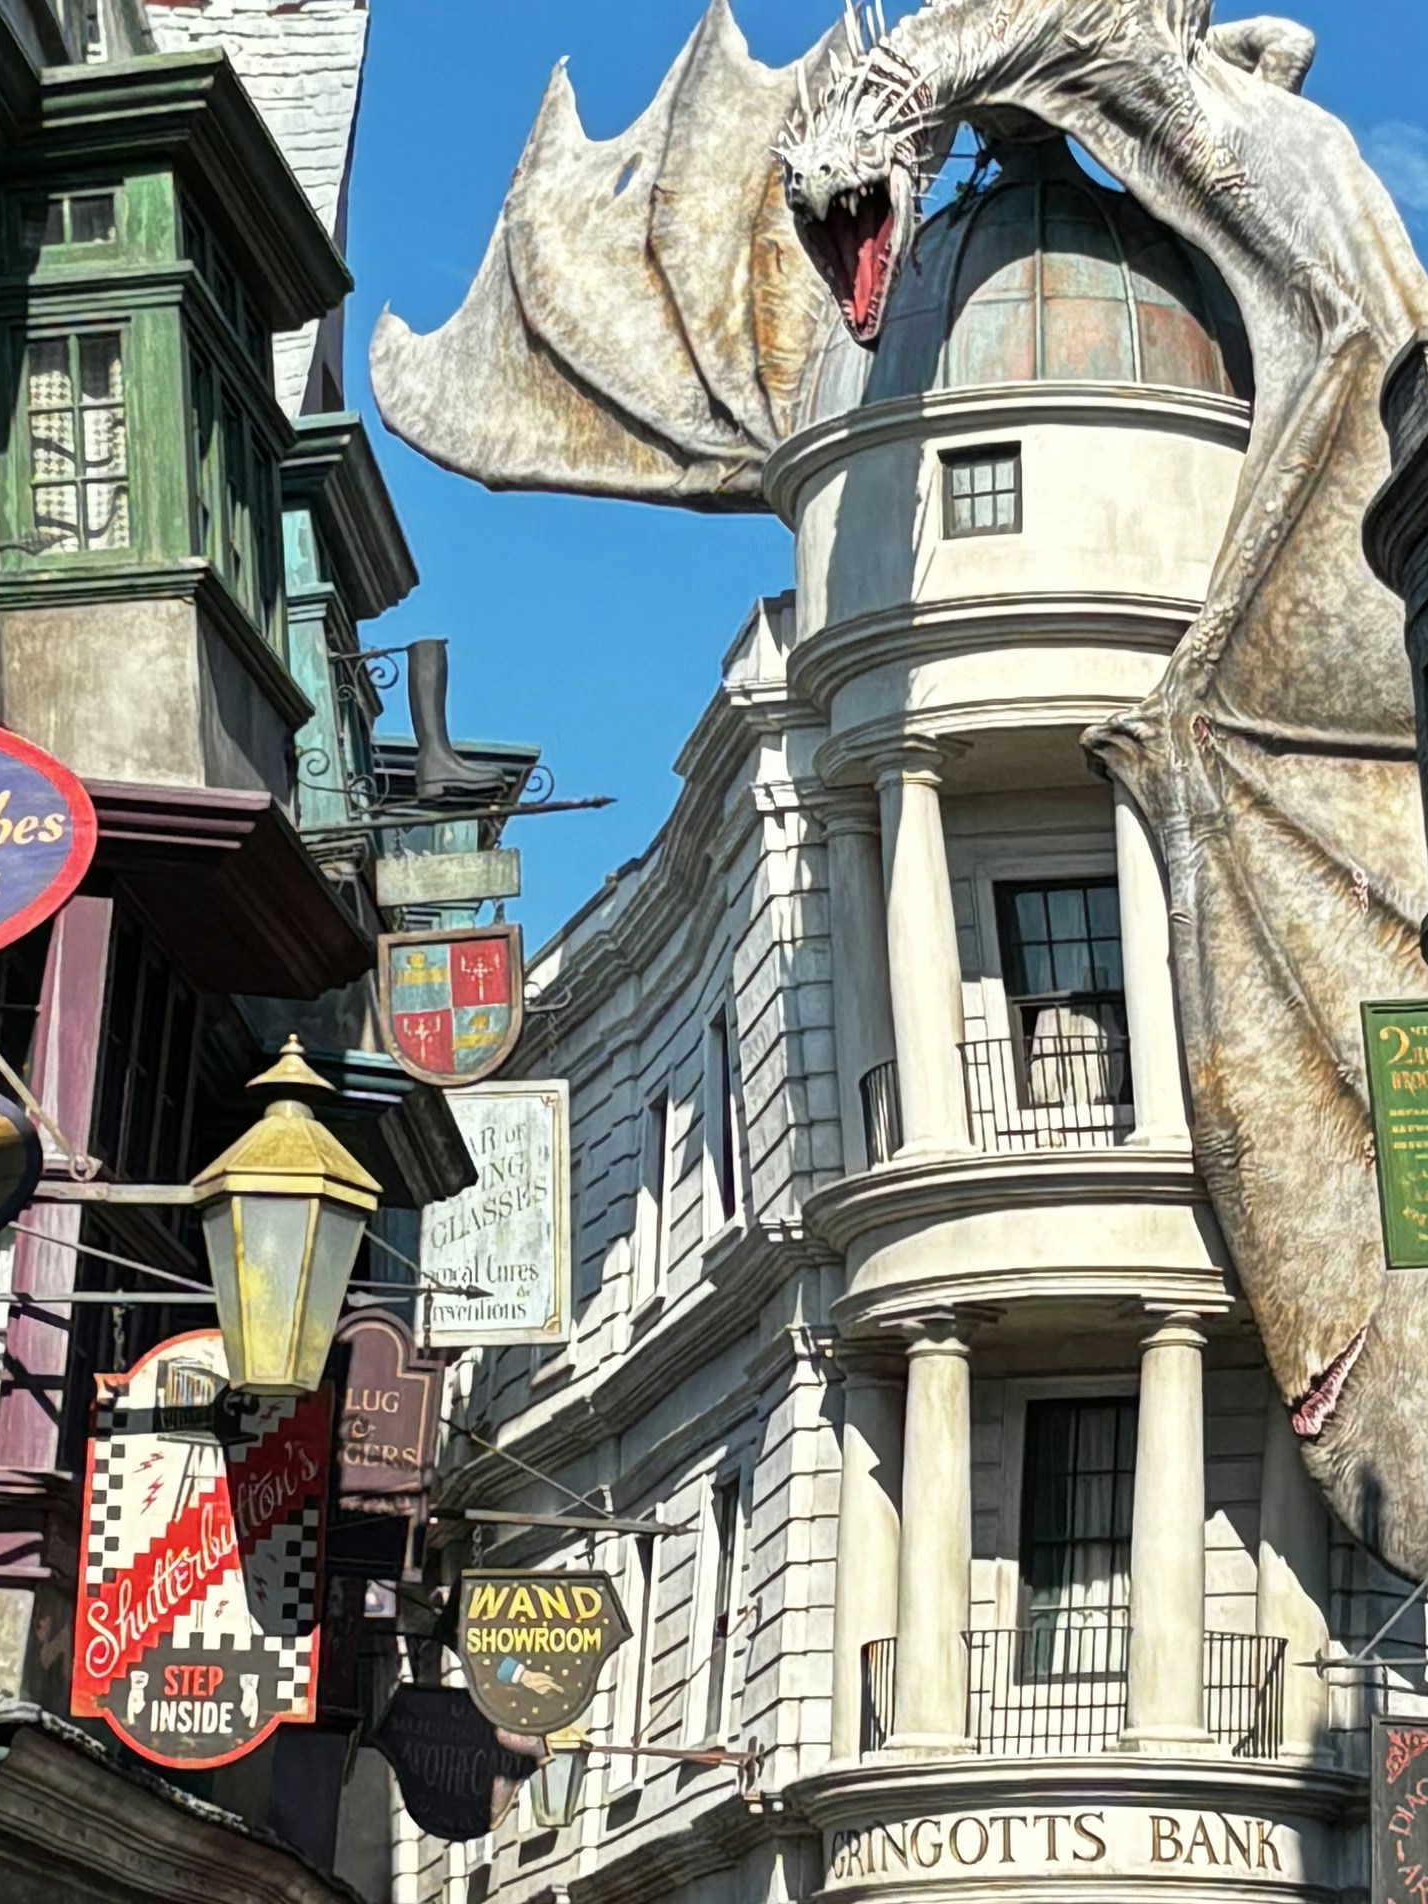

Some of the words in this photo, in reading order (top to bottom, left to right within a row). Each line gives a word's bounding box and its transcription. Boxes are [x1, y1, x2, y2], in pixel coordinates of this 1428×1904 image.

[431, 1299, 527, 1324] nventions
[344, 1387, 401, 1414] LUG
[342, 1443, 418, 1469] GERS
[85, 1440, 320, 1678] Shutterbutton's
[467, 1585, 603, 1622] WAND
[466, 1626, 603, 1656] SHOWROOM
[163, 1664, 224, 1697] STEP
[149, 1700, 234, 1736] INSIDE
[831, 1811, 1108, 1880] GRINGOTTS
[1149, 1814, 1284, 1872] BANK
